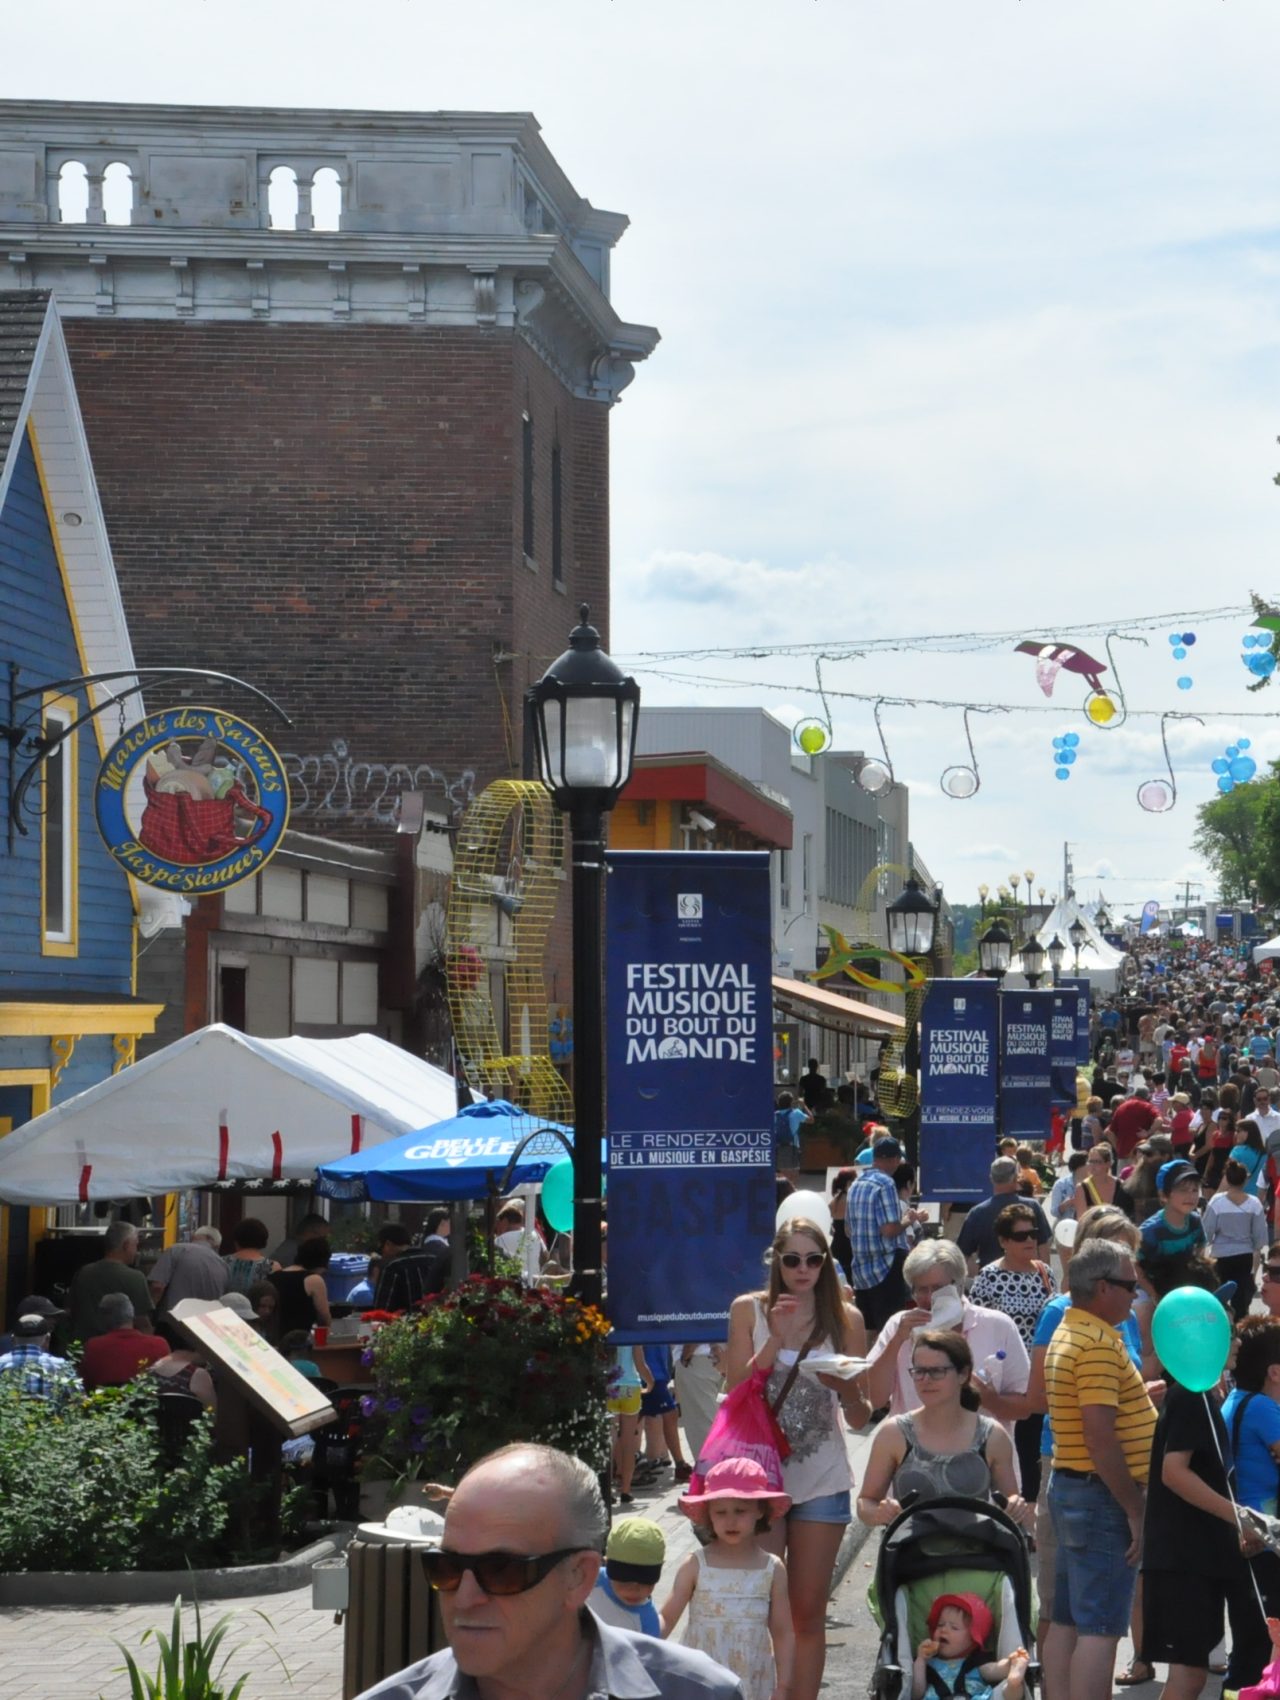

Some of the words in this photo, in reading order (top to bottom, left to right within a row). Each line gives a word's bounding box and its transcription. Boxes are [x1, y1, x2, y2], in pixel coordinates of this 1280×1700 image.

[101, 714, 168, 791] Marché
[174, 709, 206, 729] des
[209, 715, 281, 792] Saveurs
[627, 963, 756, 989] FESTIVAL
[626, 991, 756, 1016] MUSIQUE
[626, 1017, 657, 1036] DU
[663, 1017, 720, 1035] BOUT
[726, 1017, 756, 1035] DU
[1007, 1024, 1047, 1033] FESTIVAL
[929, 1030, 989, 1042] FESTIVAL
[626, 1036, 756, 1065] MONDE
[929, 1043, 989, 1054] MUSIQUE
[929, 1054, 943, 1063] DU
[947, 1054, 971, 1064] BOUT
[975, 1054, 989, 1063] DU
[929, 1063, 989, 1076] MONDE
[610, 1135, 632, 1148] LE
[643, 1132, 771, 1148] RENDEZ-VOUS
[404, 1141, 519, 1160] GUEULE
[610, 1152, 624, 1165] DE
[630, 1152, 643, 1164] LA
[649, 1151, 696, 1164] MUSIQUE
[701, 1150, 715, 1163] EN
[721, 1148, 771, 1163] GASPÉSIE
